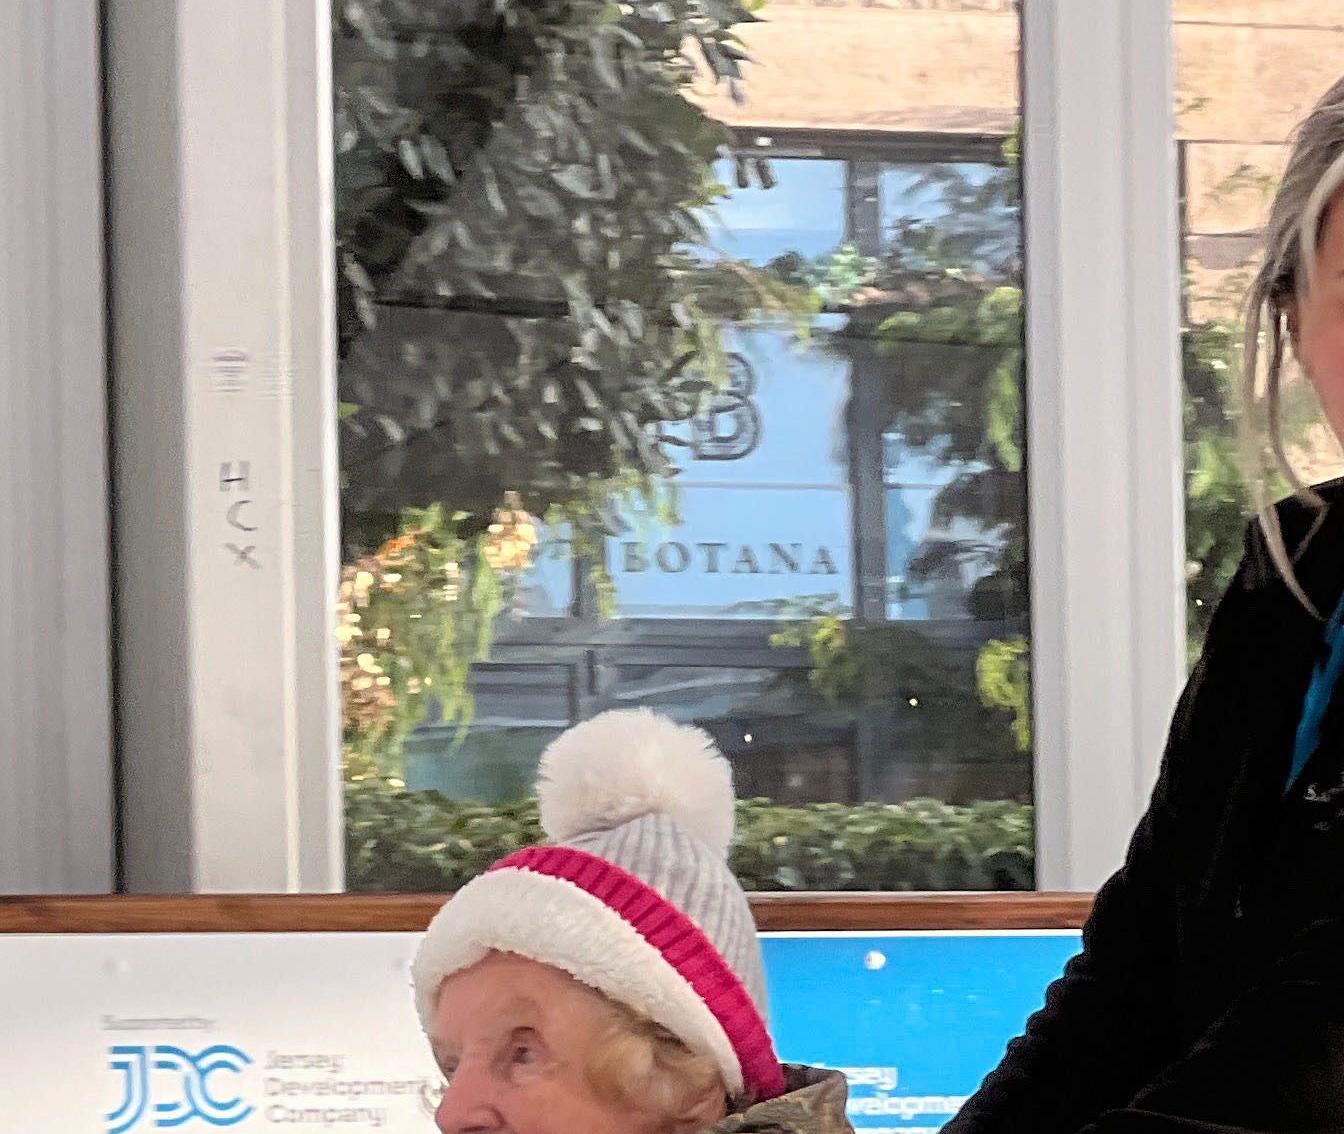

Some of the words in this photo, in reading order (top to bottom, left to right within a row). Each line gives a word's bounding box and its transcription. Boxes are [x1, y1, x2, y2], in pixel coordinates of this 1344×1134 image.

[620, 541, 840, 576] BOTANA
[264, 1051, 346, 1073] Jersey
[265, 1105, 387, 1127] Company
